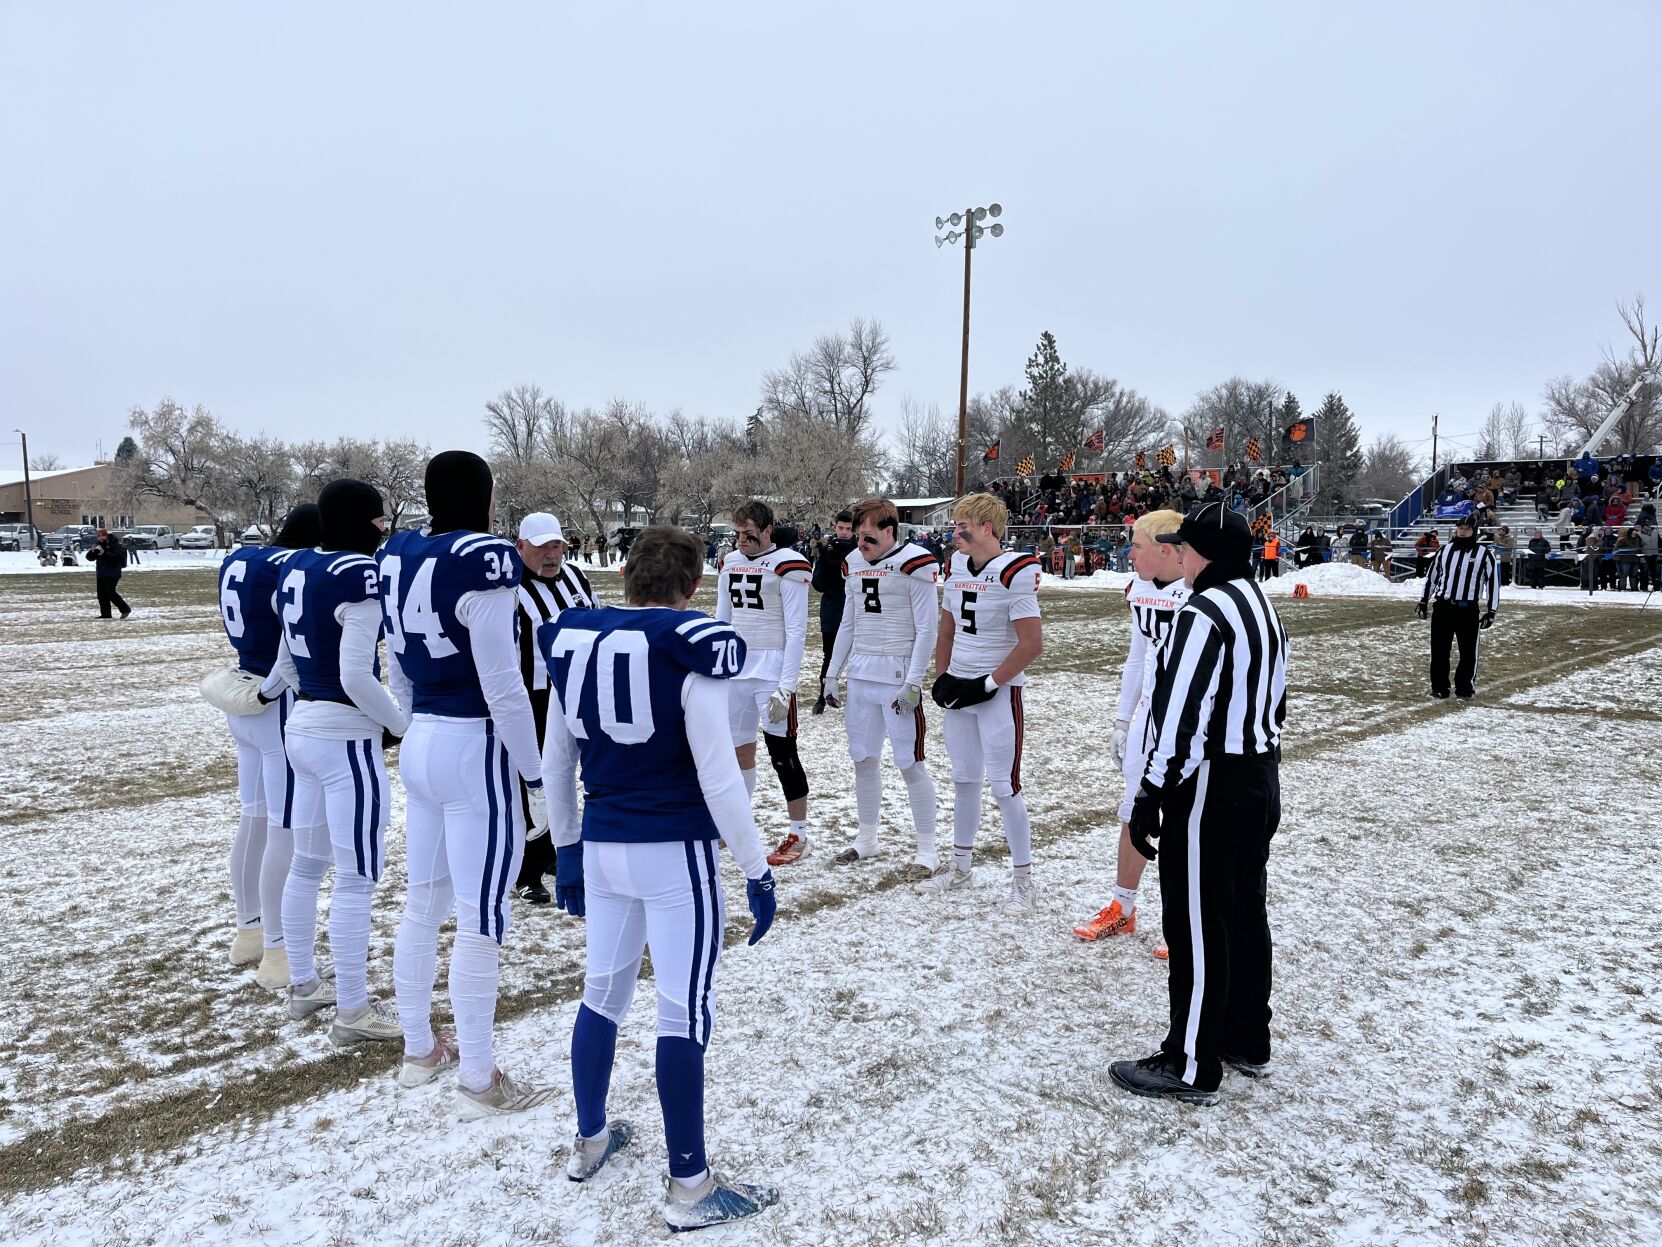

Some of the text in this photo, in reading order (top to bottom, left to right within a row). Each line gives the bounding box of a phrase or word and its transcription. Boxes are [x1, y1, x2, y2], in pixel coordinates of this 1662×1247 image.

[363, 569, 379, 595] 2
[483, 551, 513, 581] 34
[221, 560, 247, 638] 6
[729, 573, 765, 610] 63
[861, 578, 882, 613] 8
[954, 581, 988, 592] MANHATTAN
[1135, 597, 1175, 608] MANHATTAN
[282, 568, 311, 659] 2
[379, 554, 460, 659] 34
[961, 590, 978, 636] 5
[711, 638, 739, 676] 70
[551, 628, 656, 744] 70
